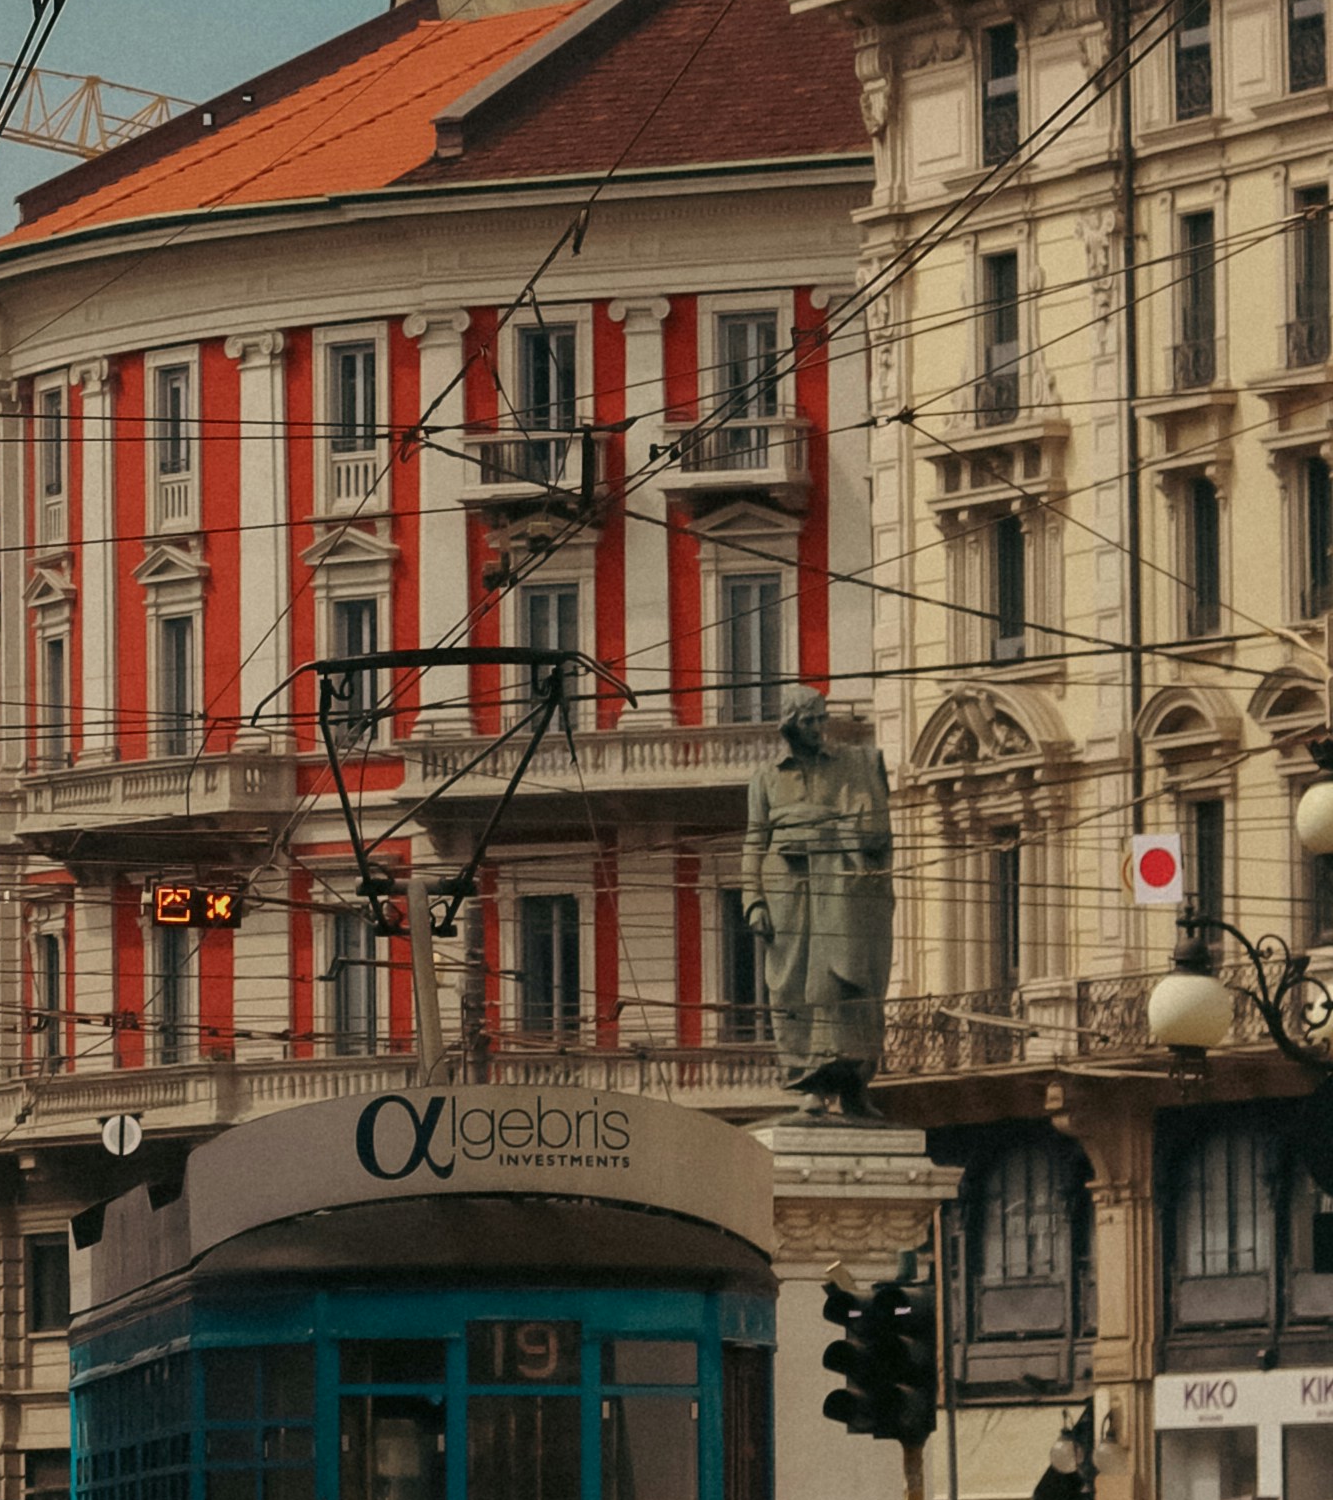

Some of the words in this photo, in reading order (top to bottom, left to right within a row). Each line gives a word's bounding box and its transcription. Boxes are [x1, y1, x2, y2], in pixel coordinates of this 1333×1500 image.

[499, 1154, 631, 1168] INVESTMENTS
[492, 1322, 558, 1378] 19
[1184, 1380, 1237, 1409] KIKO
[1301, 1376, 1333, 1404] KIK
